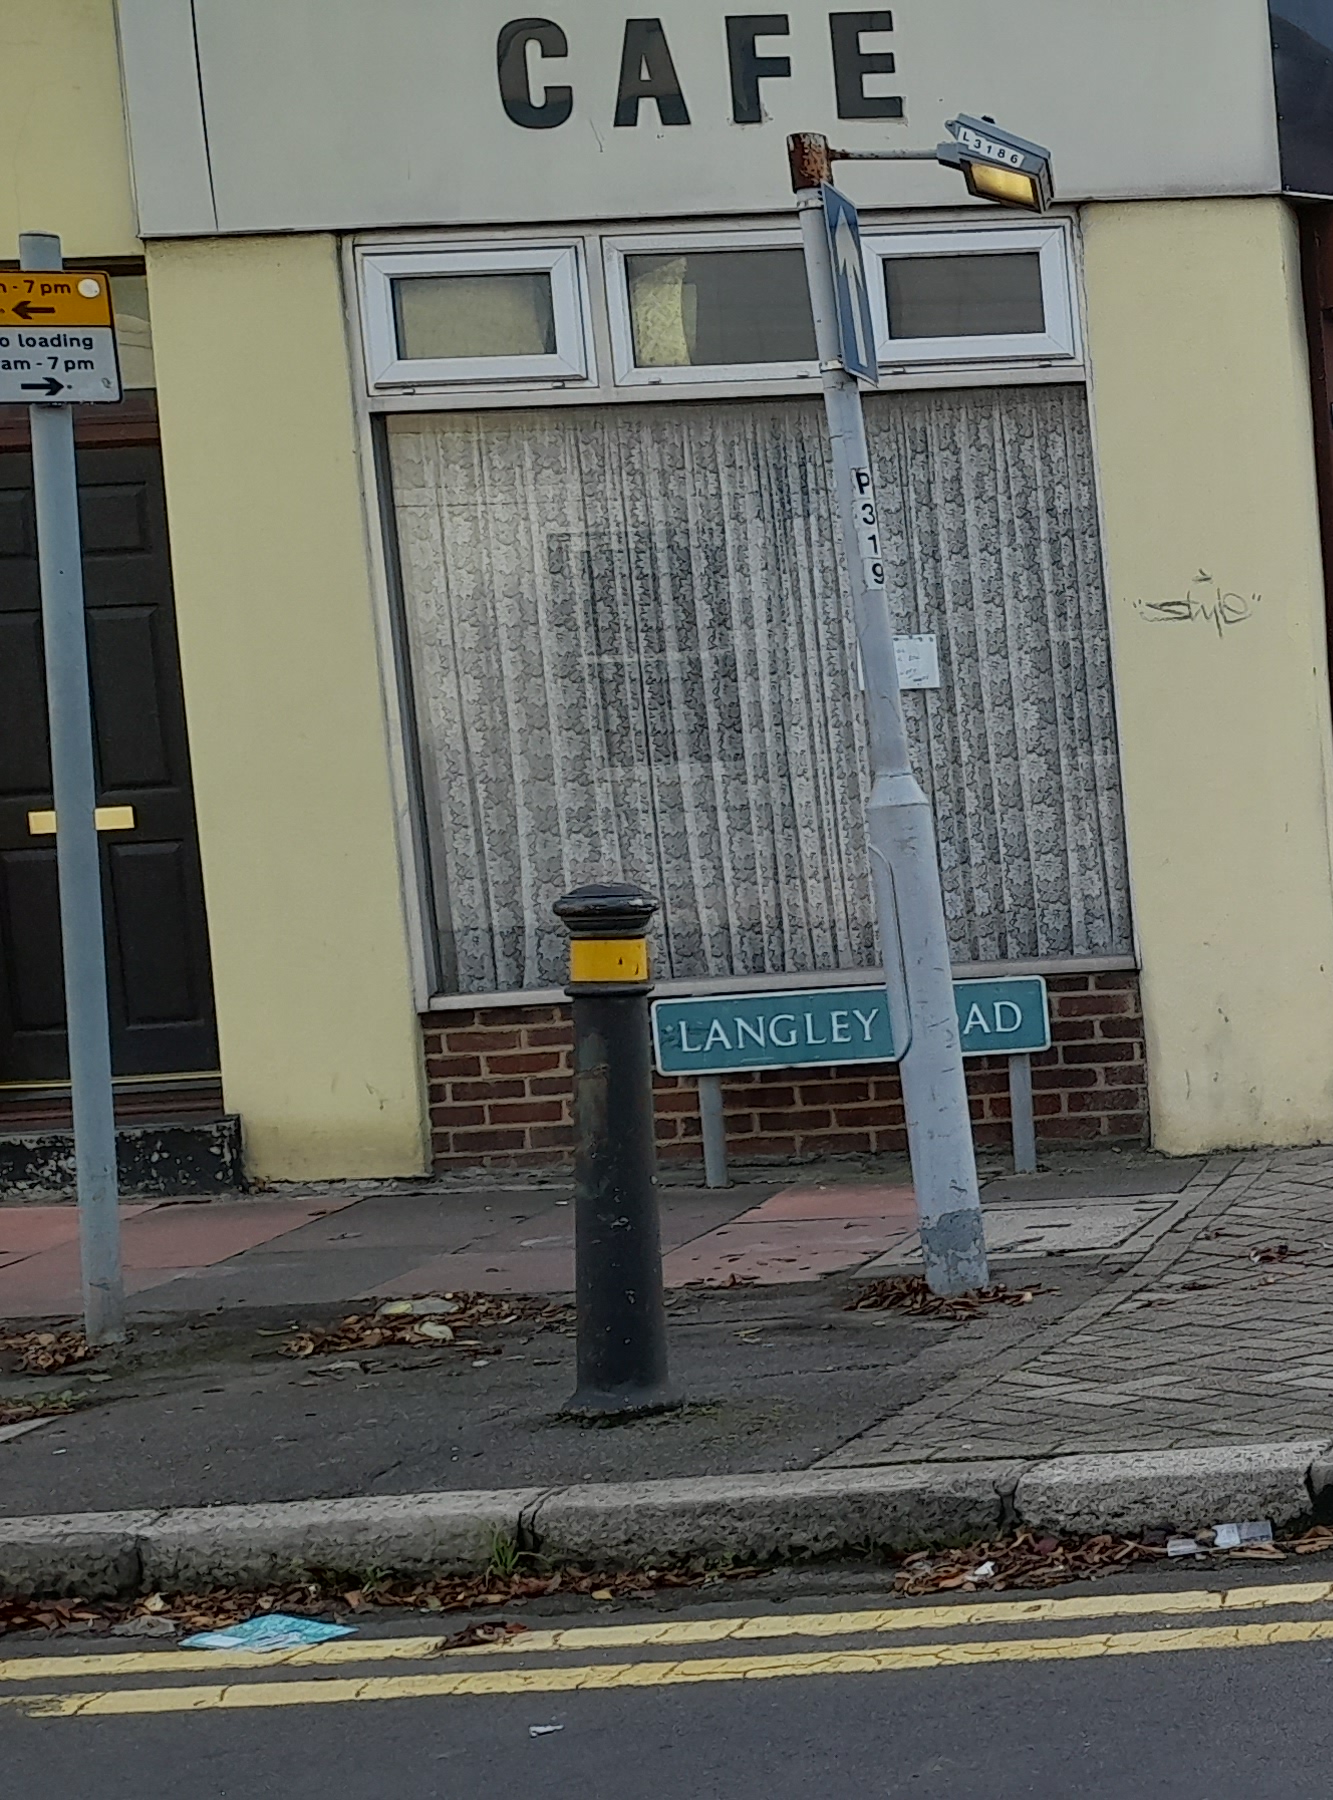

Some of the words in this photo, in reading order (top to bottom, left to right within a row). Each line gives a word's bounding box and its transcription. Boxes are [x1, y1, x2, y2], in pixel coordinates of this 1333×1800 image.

[496, 10, 904, 129] CAFE
[962, 131, 1019, 164] L3186
[40, 283, 71, 296] pm
[18, 333, 94, 350] loading
[64, 359, 95, 372] pm
[856, 471, 885, 585] P319
[679, 1007, 879, 1053] LANGLEY
[960, 1000, 1023, 1035] AD
